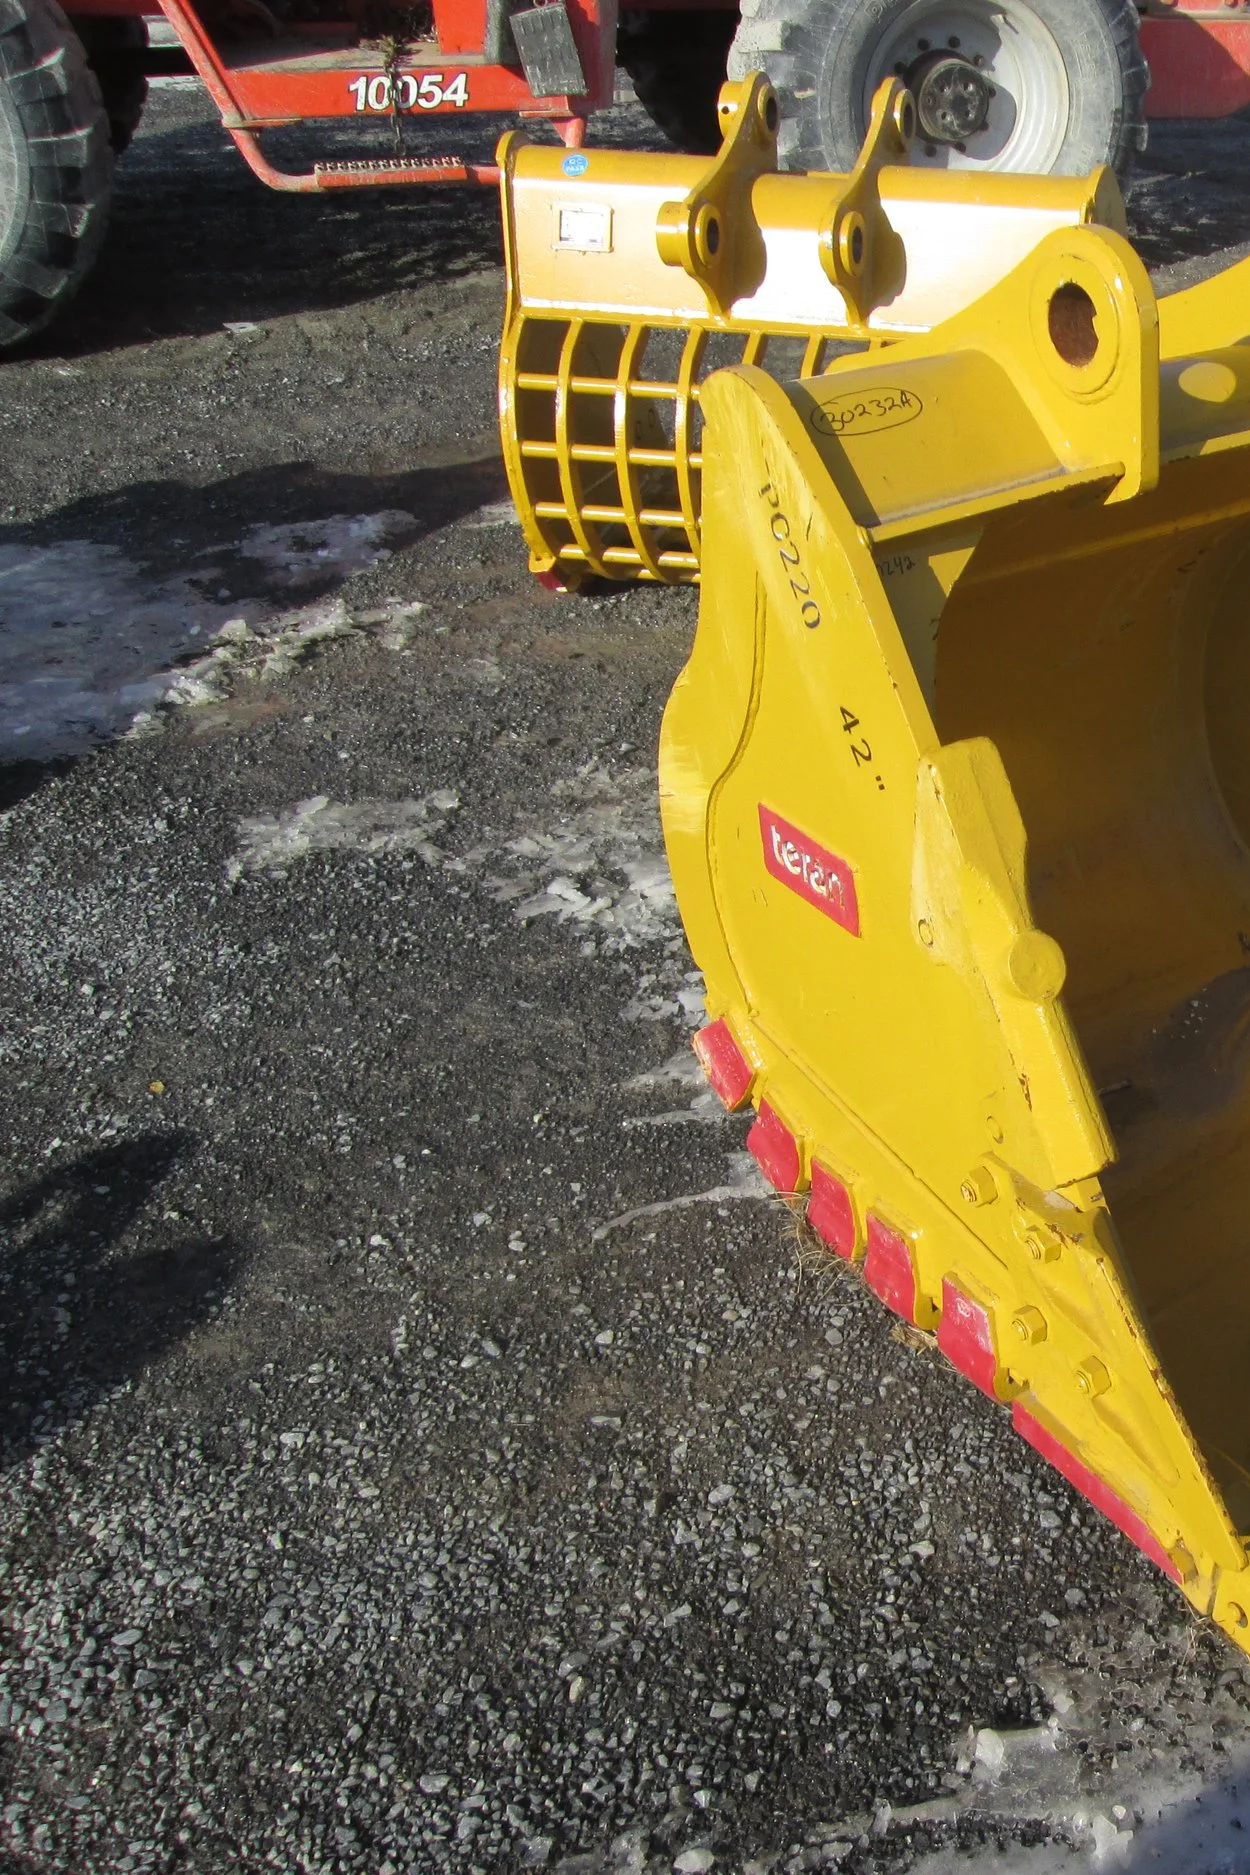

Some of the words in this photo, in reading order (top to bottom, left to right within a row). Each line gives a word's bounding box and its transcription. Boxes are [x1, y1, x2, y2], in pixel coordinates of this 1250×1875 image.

[349, 73, 469, 111] 10054
[820, 390, 913, 431] 30232A
[759, 482, 821, 629] PC220
[770, 824, 846, 910] teran
